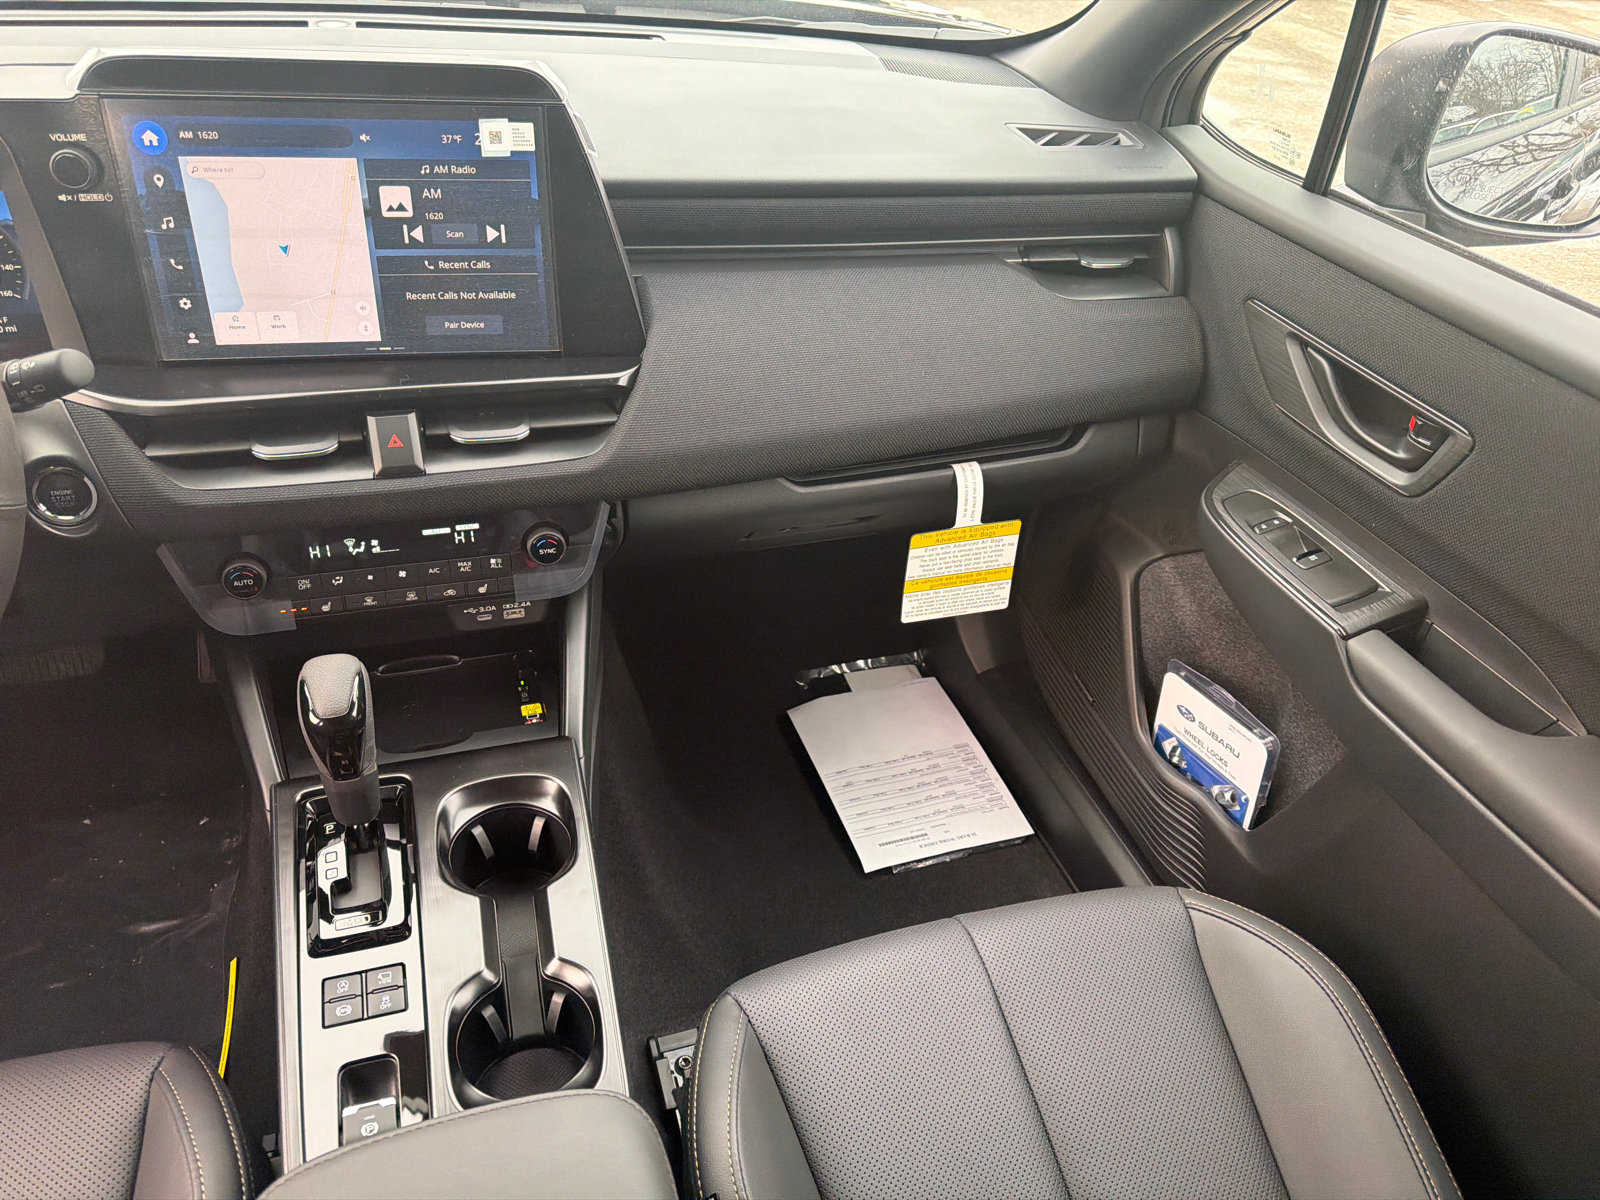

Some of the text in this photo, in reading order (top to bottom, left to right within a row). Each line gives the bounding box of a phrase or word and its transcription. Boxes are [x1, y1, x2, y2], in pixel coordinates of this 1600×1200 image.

[49, 133, 87, 142] VOLUME
[179, 131, 219, 139] AM 1620
[441, 135, 462, 144] 37°F
[433, 166, 476, 174] AM Radio
[422, 188, 442, 199] AM
[425, 212, 444, 220] 1620
[446, 230, 464, 238] Scan
[438, 260, 491, 269] Recent Calls
[406, 291, 516, 300] Recent Calls Not Available
[5, 325, 18, 333] mi
[969, 525, 999, 533] Equipped
[454, 530, 474, 544] HI
[935, 535, 966, 544] Advanced
[953, 541, 979, 549] Advanced
[309, 545, 331, 559] HI
[930, 577, 988, 590] gonflables intelligents
[1198, 721, 1241, 759] SUBARU
[1183, 727, 1205, 750] WHEEL
[1206, 746, 1228, 767] LOCKS
